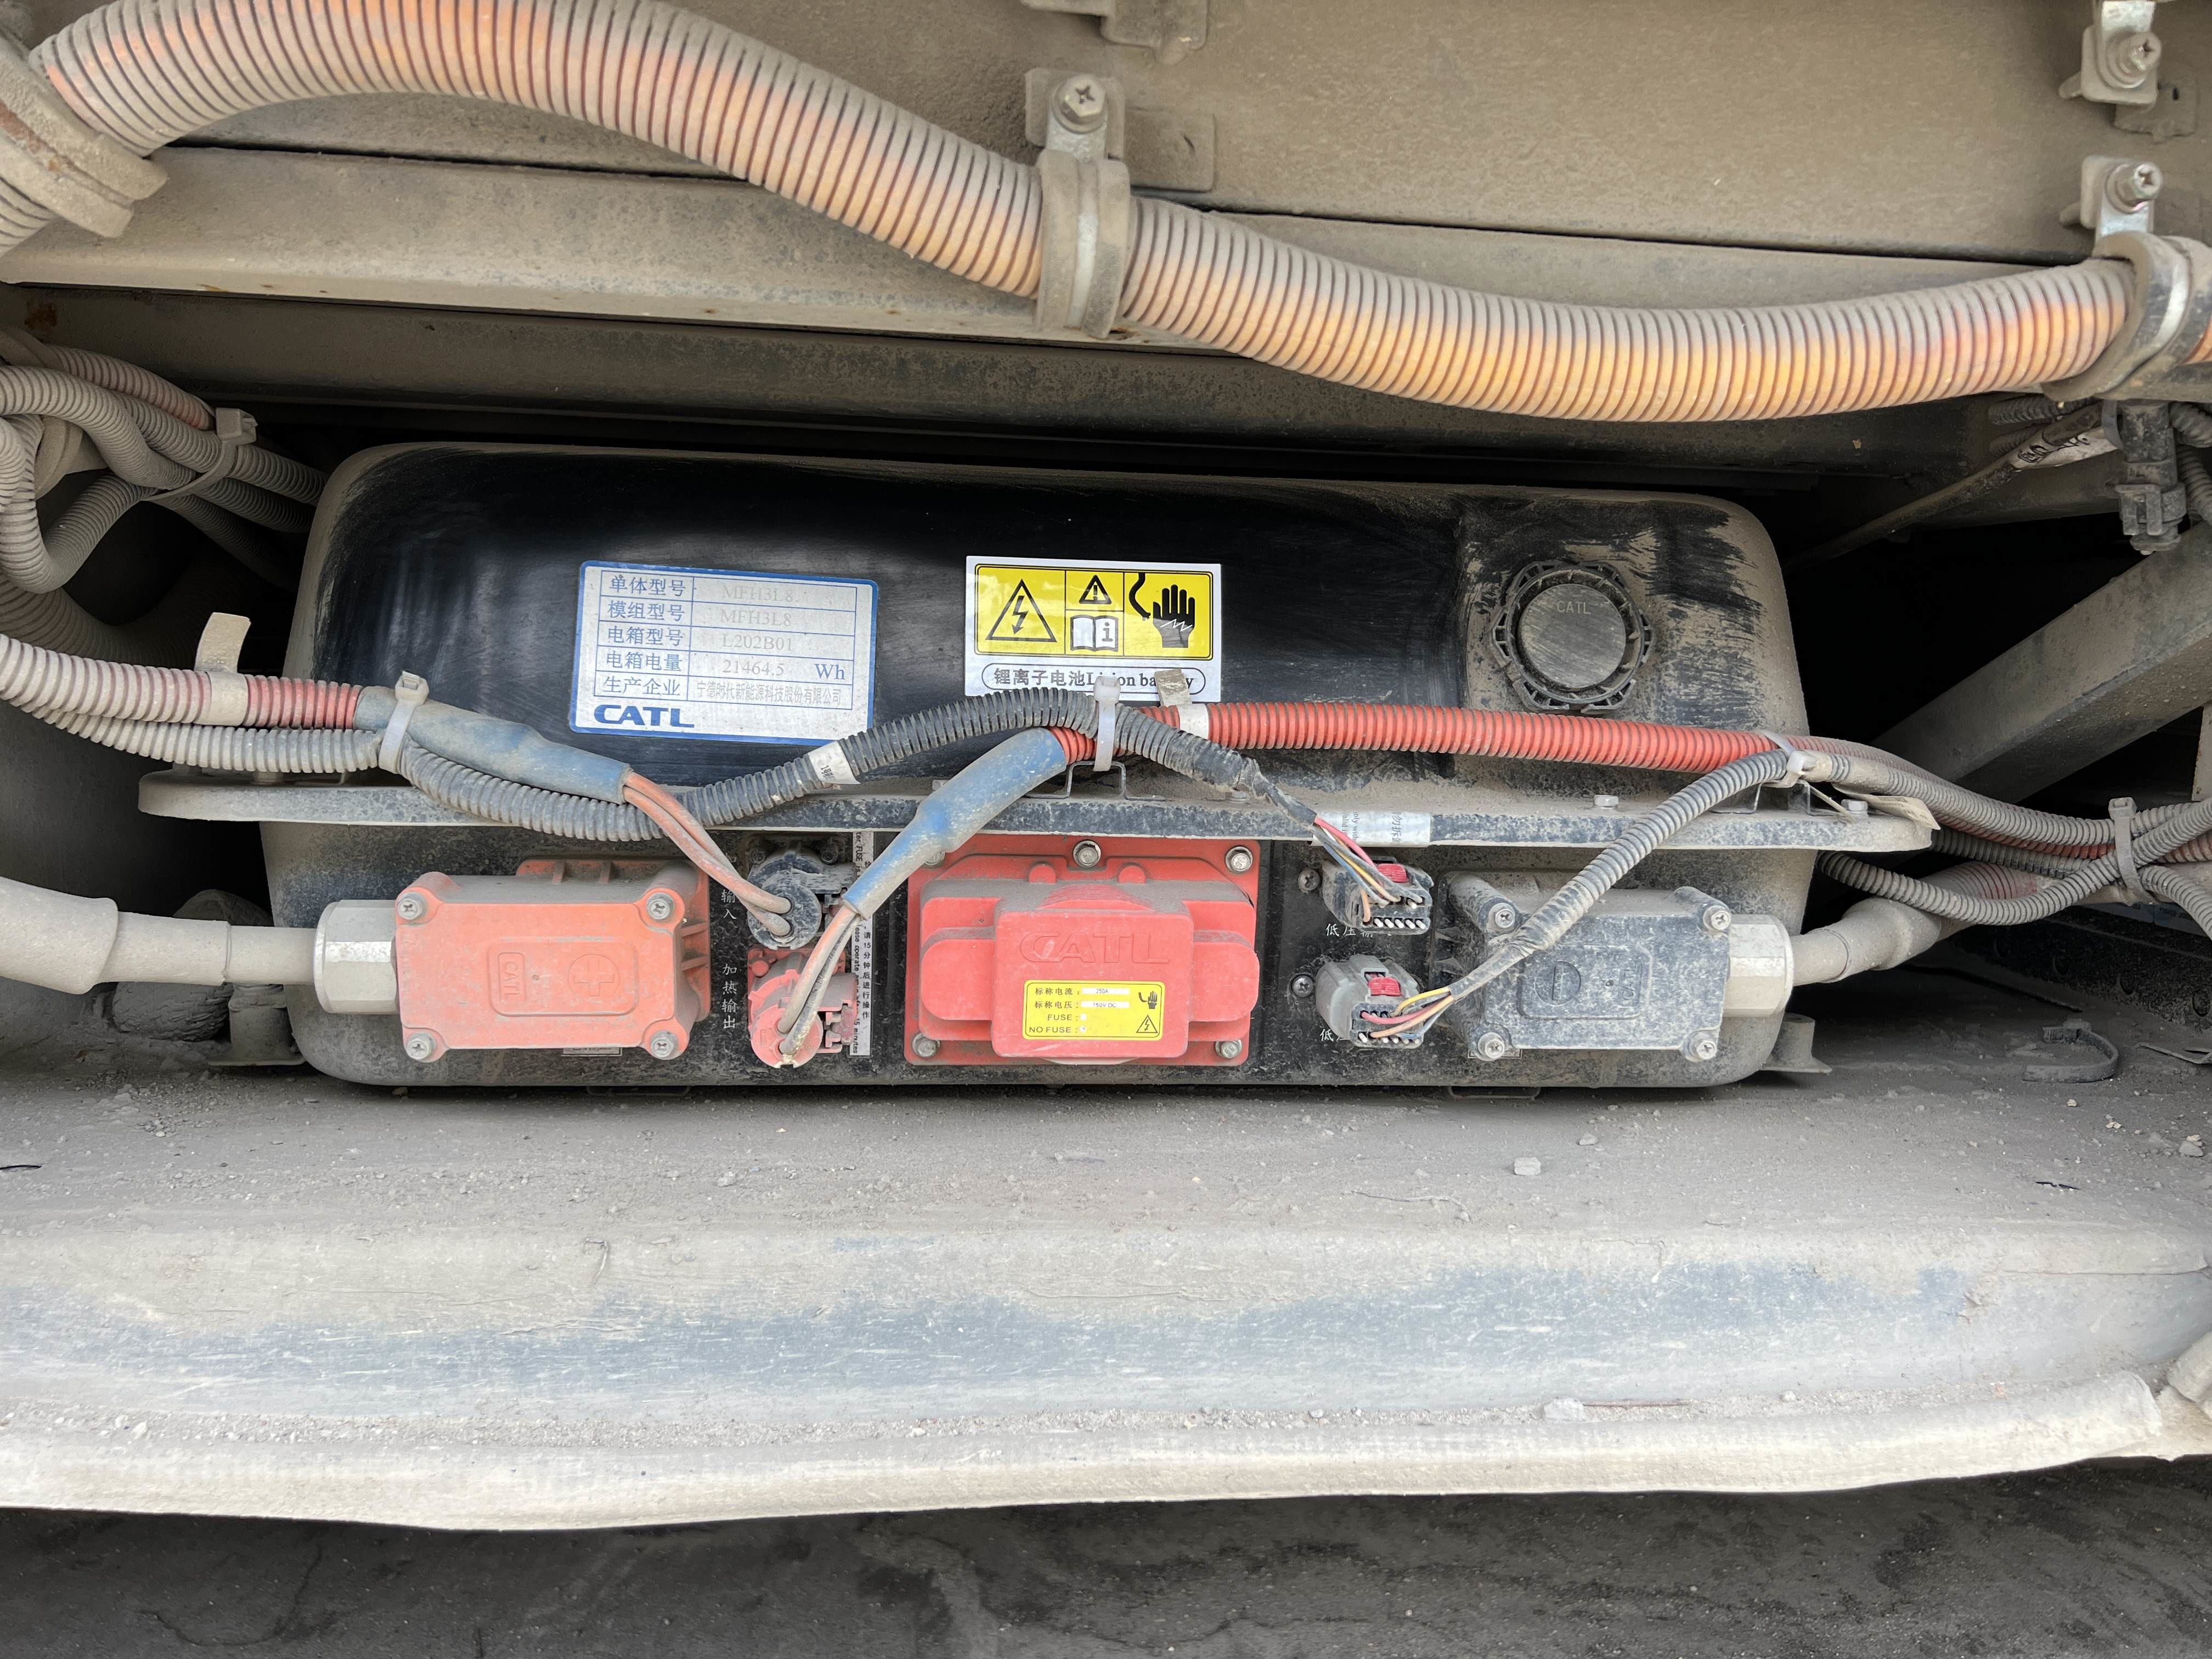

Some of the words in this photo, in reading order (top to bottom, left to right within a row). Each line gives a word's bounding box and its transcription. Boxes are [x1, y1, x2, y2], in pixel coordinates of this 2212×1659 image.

[609, 575, 686, 597] 单体型号
[608, 600, 685, 622] 模组型号
[720, 609, 792, 627] MFH3L8
[1557, 600, 1592, 614] CATL
[607, 625, 684, 647] 电箱型号
[722, 635, 793, 652] L202B01
[606, 651, 682, 672] 电箱电量
[722, 658, 785, 676] 21464.5
[815, 663, 846, 680] Wh
[603, 676, 681, 697] 生产企业
[697, 680, 842, 706] 宁德时代新能源科技股份有限公司
[594, 704, 695, 728] CATL
[1019, 932, 1169, 964] CATL
[503, 961, 519, 1000] CATL
[721, 963, 738, 1029] 加热输出
